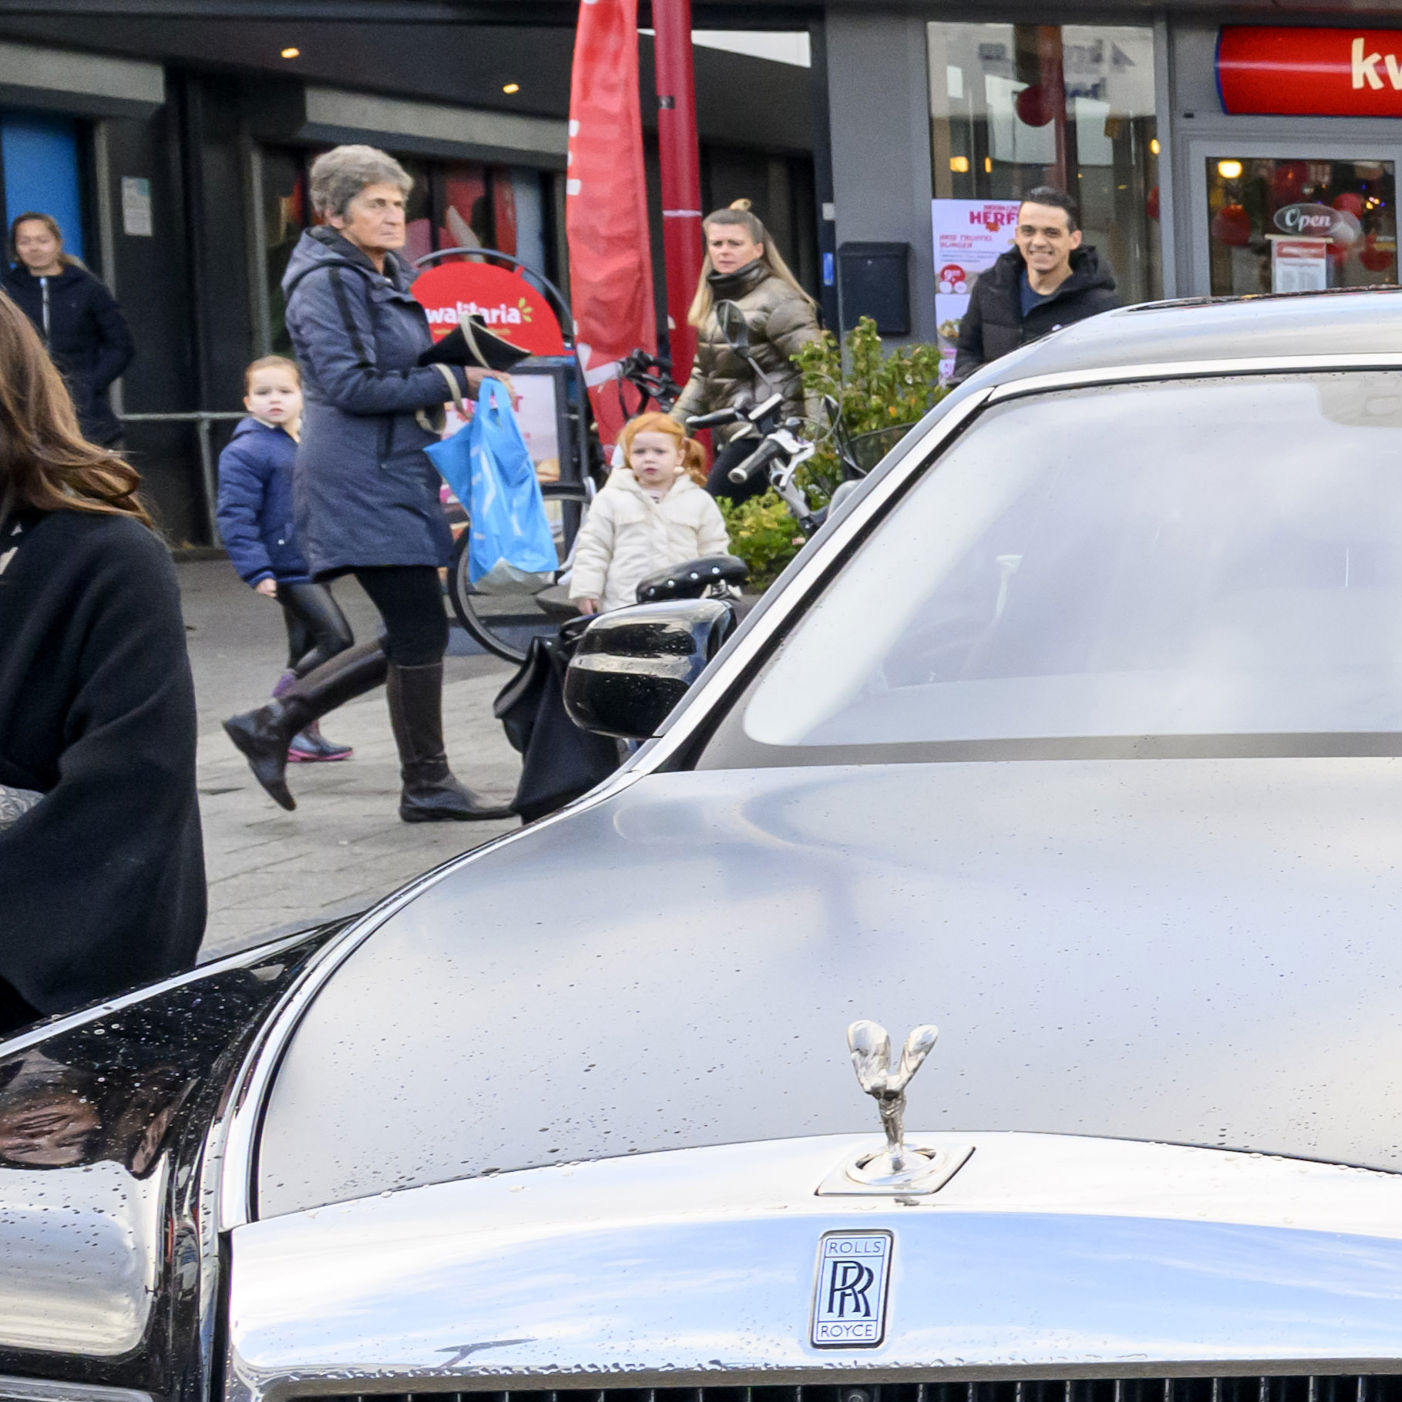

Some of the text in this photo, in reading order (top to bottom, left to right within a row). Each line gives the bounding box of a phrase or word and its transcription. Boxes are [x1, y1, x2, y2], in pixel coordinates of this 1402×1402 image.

[969, 211, 1019, 225] HERF
[1284, 207, 1331, 232] Open
[829, 1241, 881, 1254] ROLLS
[820, 1324, 873, 1338] ROYCE
